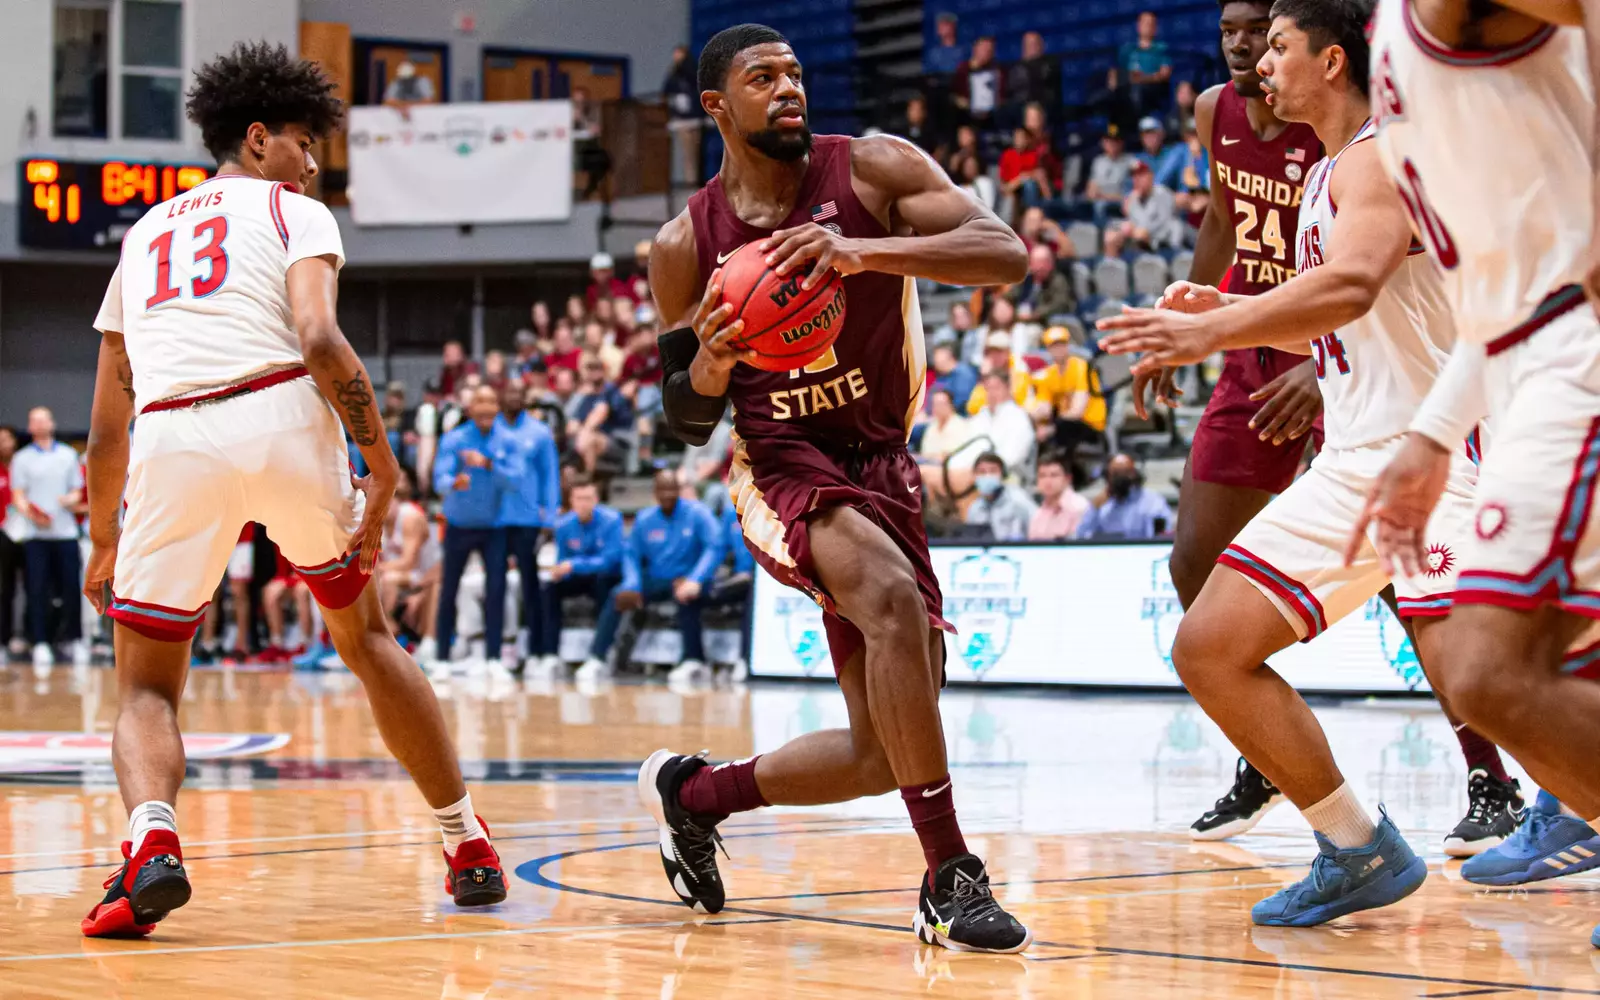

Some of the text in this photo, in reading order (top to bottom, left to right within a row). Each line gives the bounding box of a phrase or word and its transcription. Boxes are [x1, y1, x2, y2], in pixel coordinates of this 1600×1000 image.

[33, 183, 81, 224] 41
[167, 191, 223, 219] LEWIS
[1234, 198, 1287, 260] 24
[145, 215, 230, 312] 13
[1240, 258, 1297, 285] TAT
[780, 286, 845, 345] Wilson
[769, 367, 868, 420] STATE
